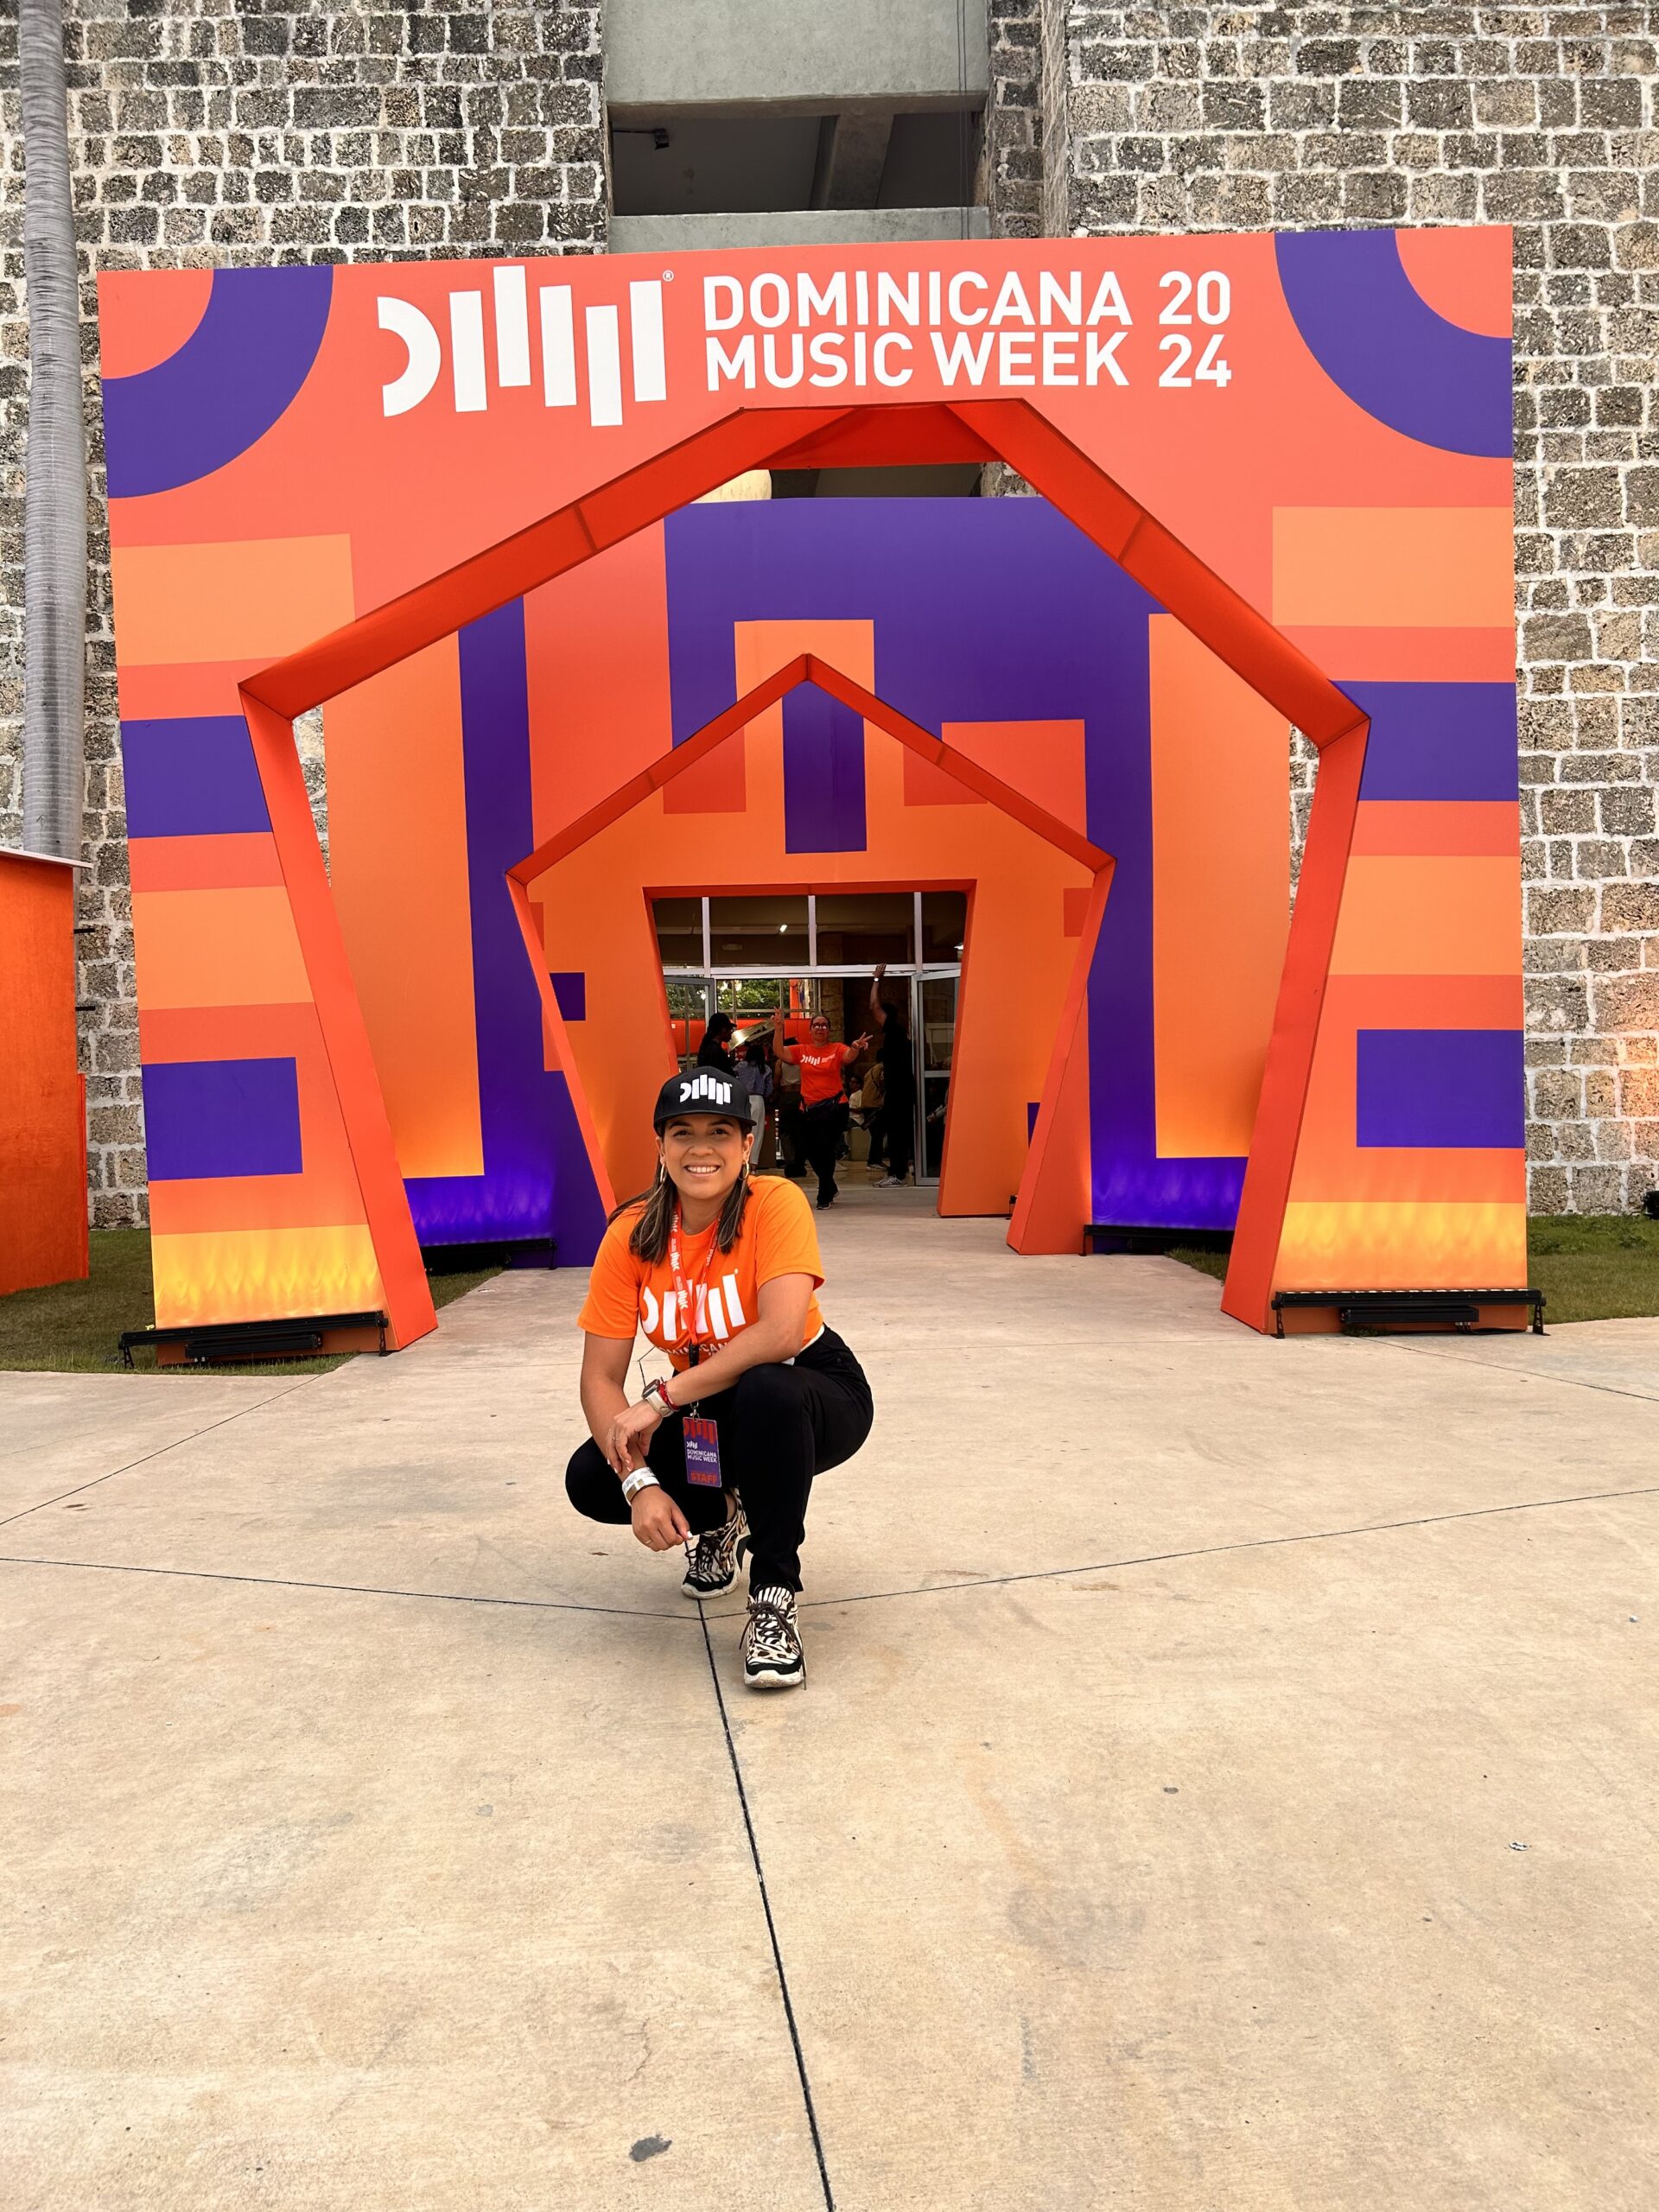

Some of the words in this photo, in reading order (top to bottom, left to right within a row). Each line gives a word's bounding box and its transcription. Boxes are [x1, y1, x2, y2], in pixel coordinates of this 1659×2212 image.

[704, 270, 1133, 330] DOMINICANA
[1160, 270, 1230, 325] 20
[706, 332, 912, 391] MUSIC
[930, 331, 1129, 386] WEEK
[1159, 334, 1231, 388] 24
[686, 1449, 717, 1458] DOMINICANA
[690, 1471, 717, 1484] STAFF
